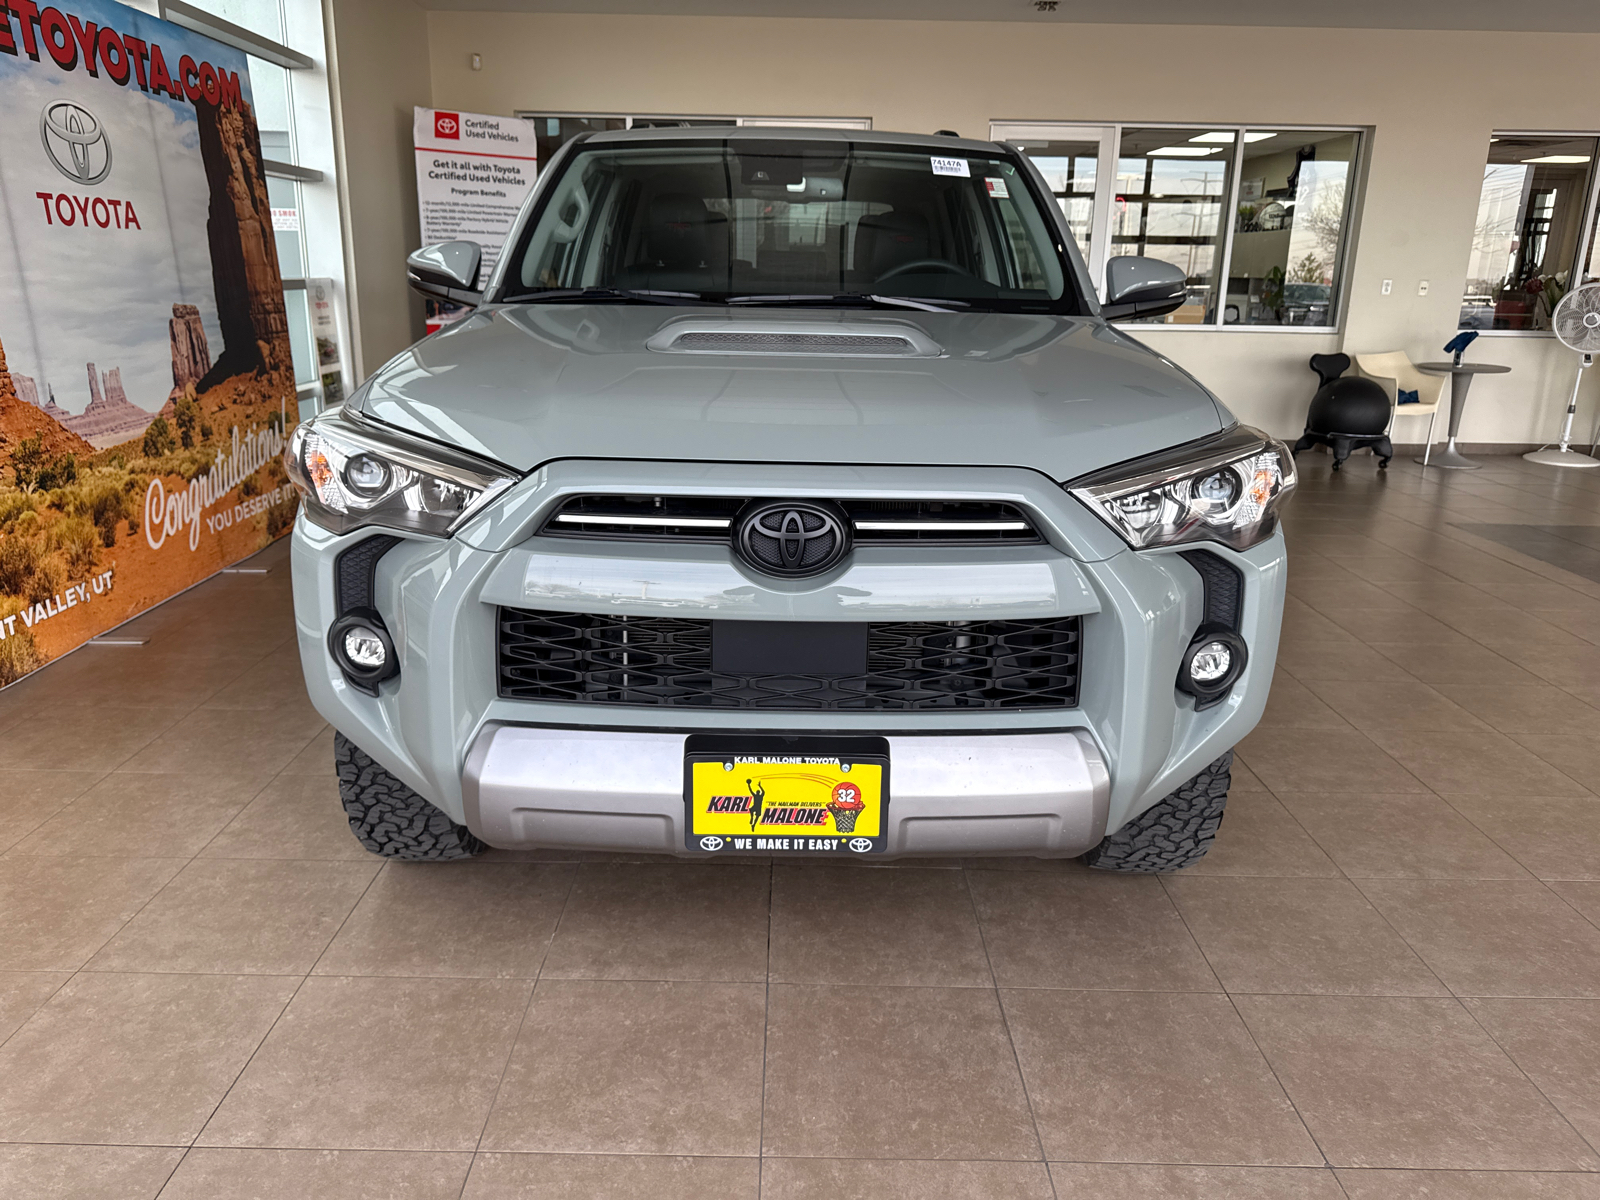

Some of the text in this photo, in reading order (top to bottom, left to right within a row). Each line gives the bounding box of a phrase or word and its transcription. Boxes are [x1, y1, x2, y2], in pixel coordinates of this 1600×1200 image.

[465, 119, 500, 130] Certified
[465, 129, 519, 142] Used Vehicles
[433, 159, 521, 175] Get it all with Toyota
[428, 170, 526, 186] Certified Used Vehicles
[451, 187, 507, 198] Program Benefits
[36, 191, 142, 230] TOYOTA
[145, 396, 287, 551] Congratulations!
[206, 483, 296, 535] YOU DESERVE IT!
[20, 582, 91, 628] VALLEY,
[92, 570, 113, 596] UT
[734, 756, 840, 765] KARL MALONE TOYOTA
[837, 788, 855, 803] 32
[706, 795, 753, 814] KARL
[760, 808, 829, 826] MALONE
[734, 838, 838, 850] WE MAKE IT EASY
